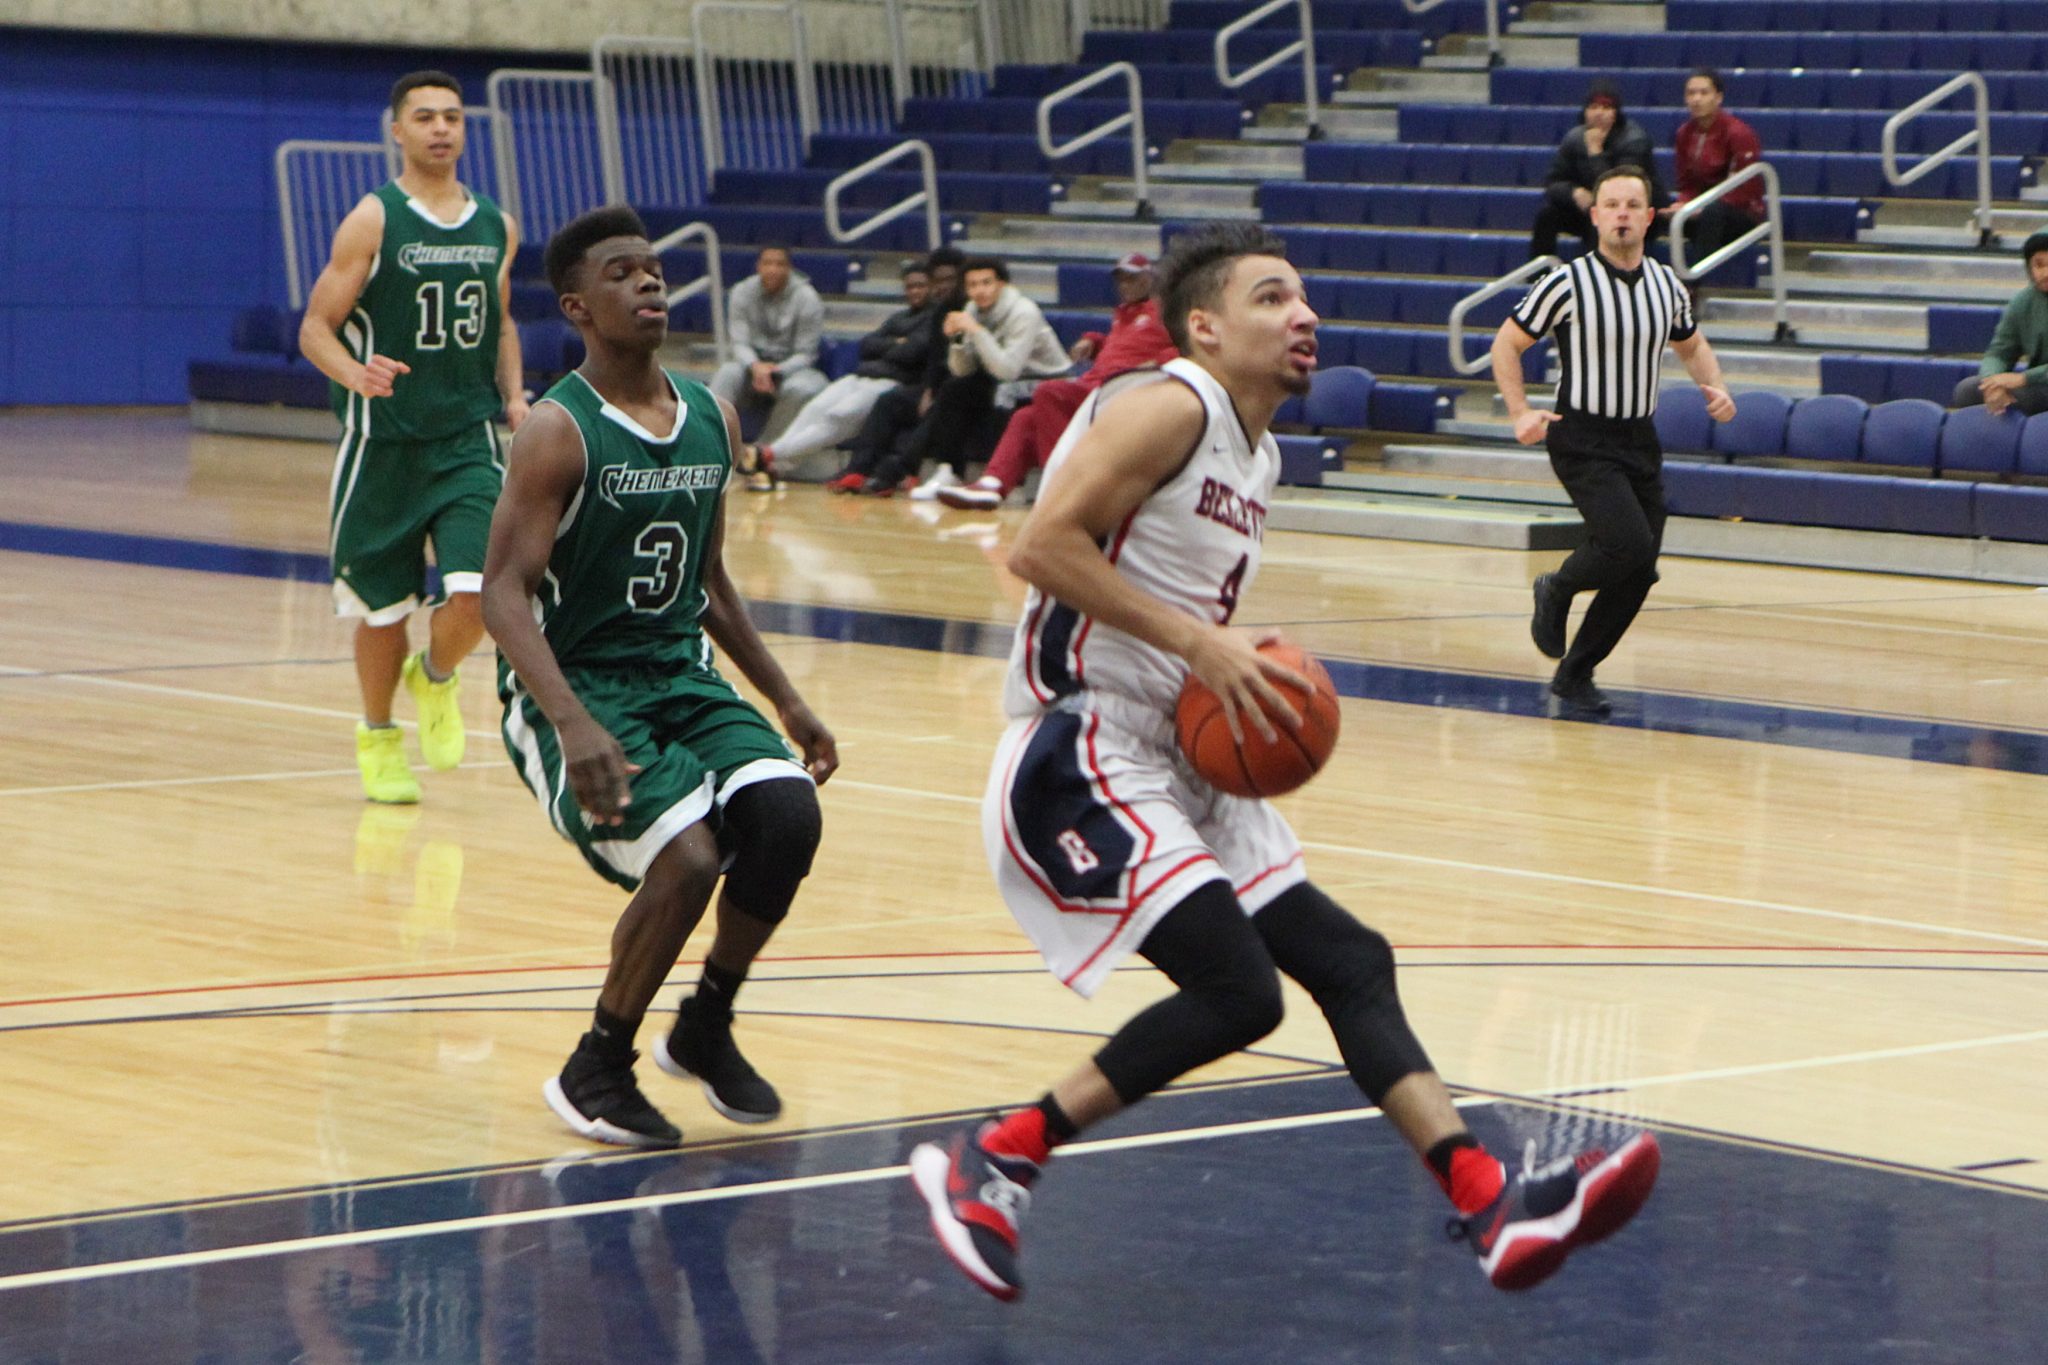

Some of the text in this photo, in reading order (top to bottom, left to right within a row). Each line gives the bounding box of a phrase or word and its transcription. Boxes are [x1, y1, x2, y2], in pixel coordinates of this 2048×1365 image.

[416, 280, 487, 349] 13
[600, 461, 723, 511] CHEMEKETA
[626, 521, 688, 615] 3
